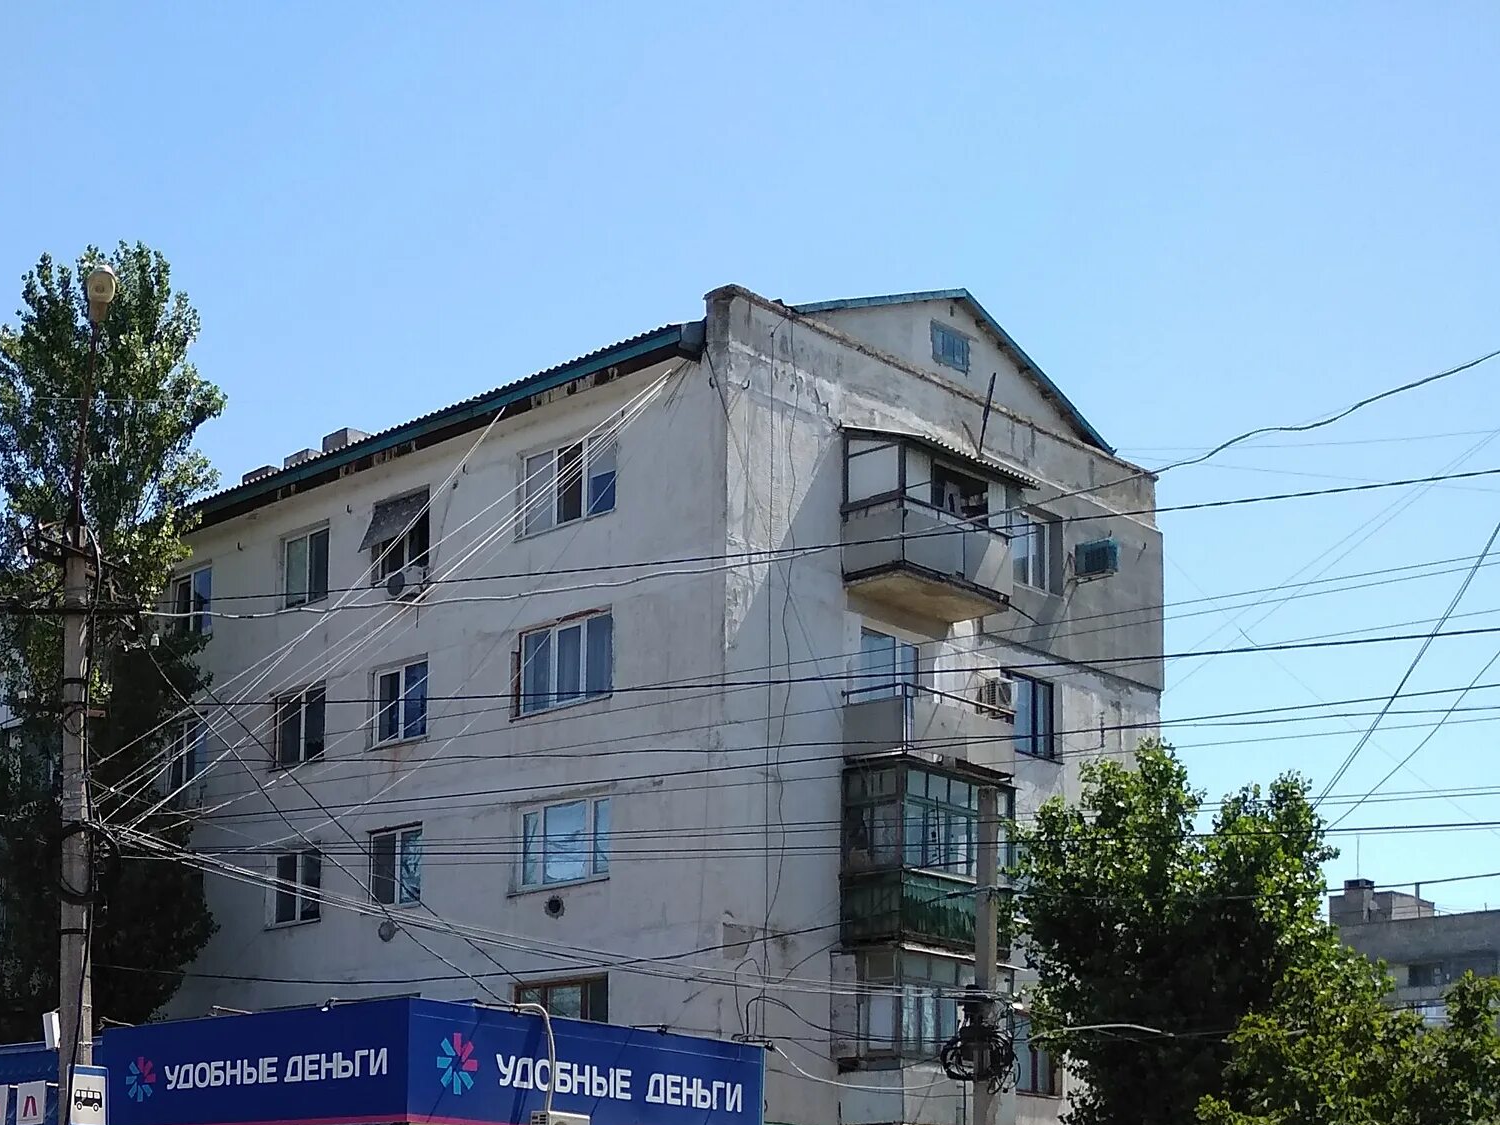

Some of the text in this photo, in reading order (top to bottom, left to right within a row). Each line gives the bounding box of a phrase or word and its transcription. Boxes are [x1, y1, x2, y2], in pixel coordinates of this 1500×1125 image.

[164, 1048, 388, 1090] УДОБНЫЕ ДЕНЬГИ
[495, 1053, 743, 1113] УДОБНЫЕ ДЕНЬГИ
